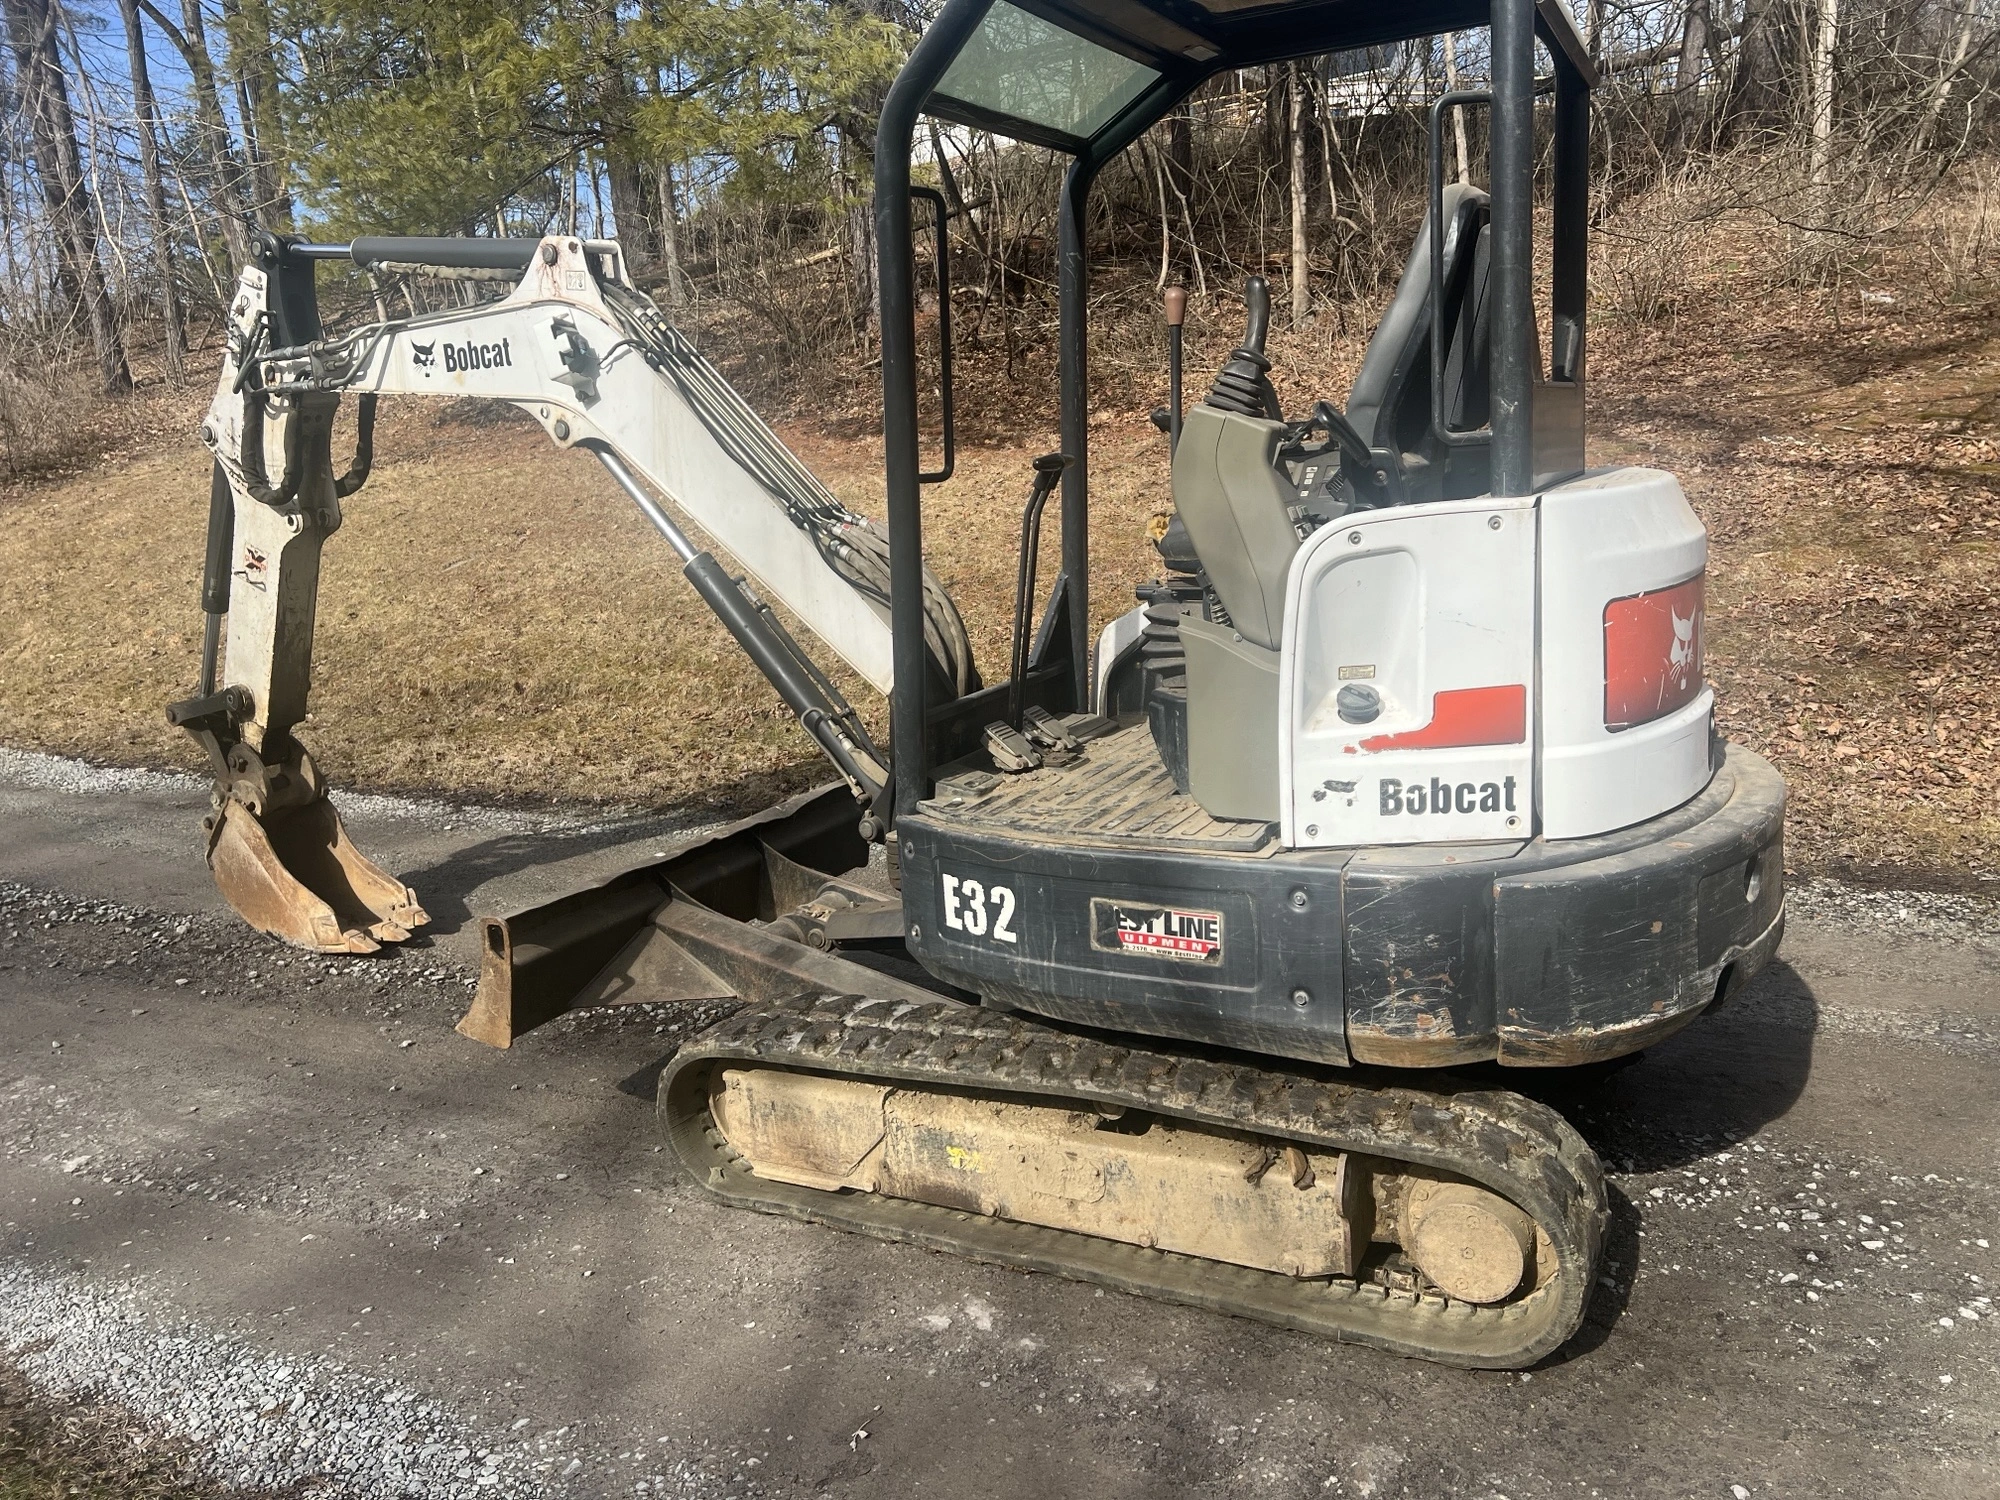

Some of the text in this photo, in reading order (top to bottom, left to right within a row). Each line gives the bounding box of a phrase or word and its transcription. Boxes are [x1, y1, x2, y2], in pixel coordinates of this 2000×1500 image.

[443, 338, 512, 372] Bobcat
[1380, 776, 1516, 816] Bobcat
[943, 873, 1017, 943] E32
[1164, 911, 1218, 941] LINE
